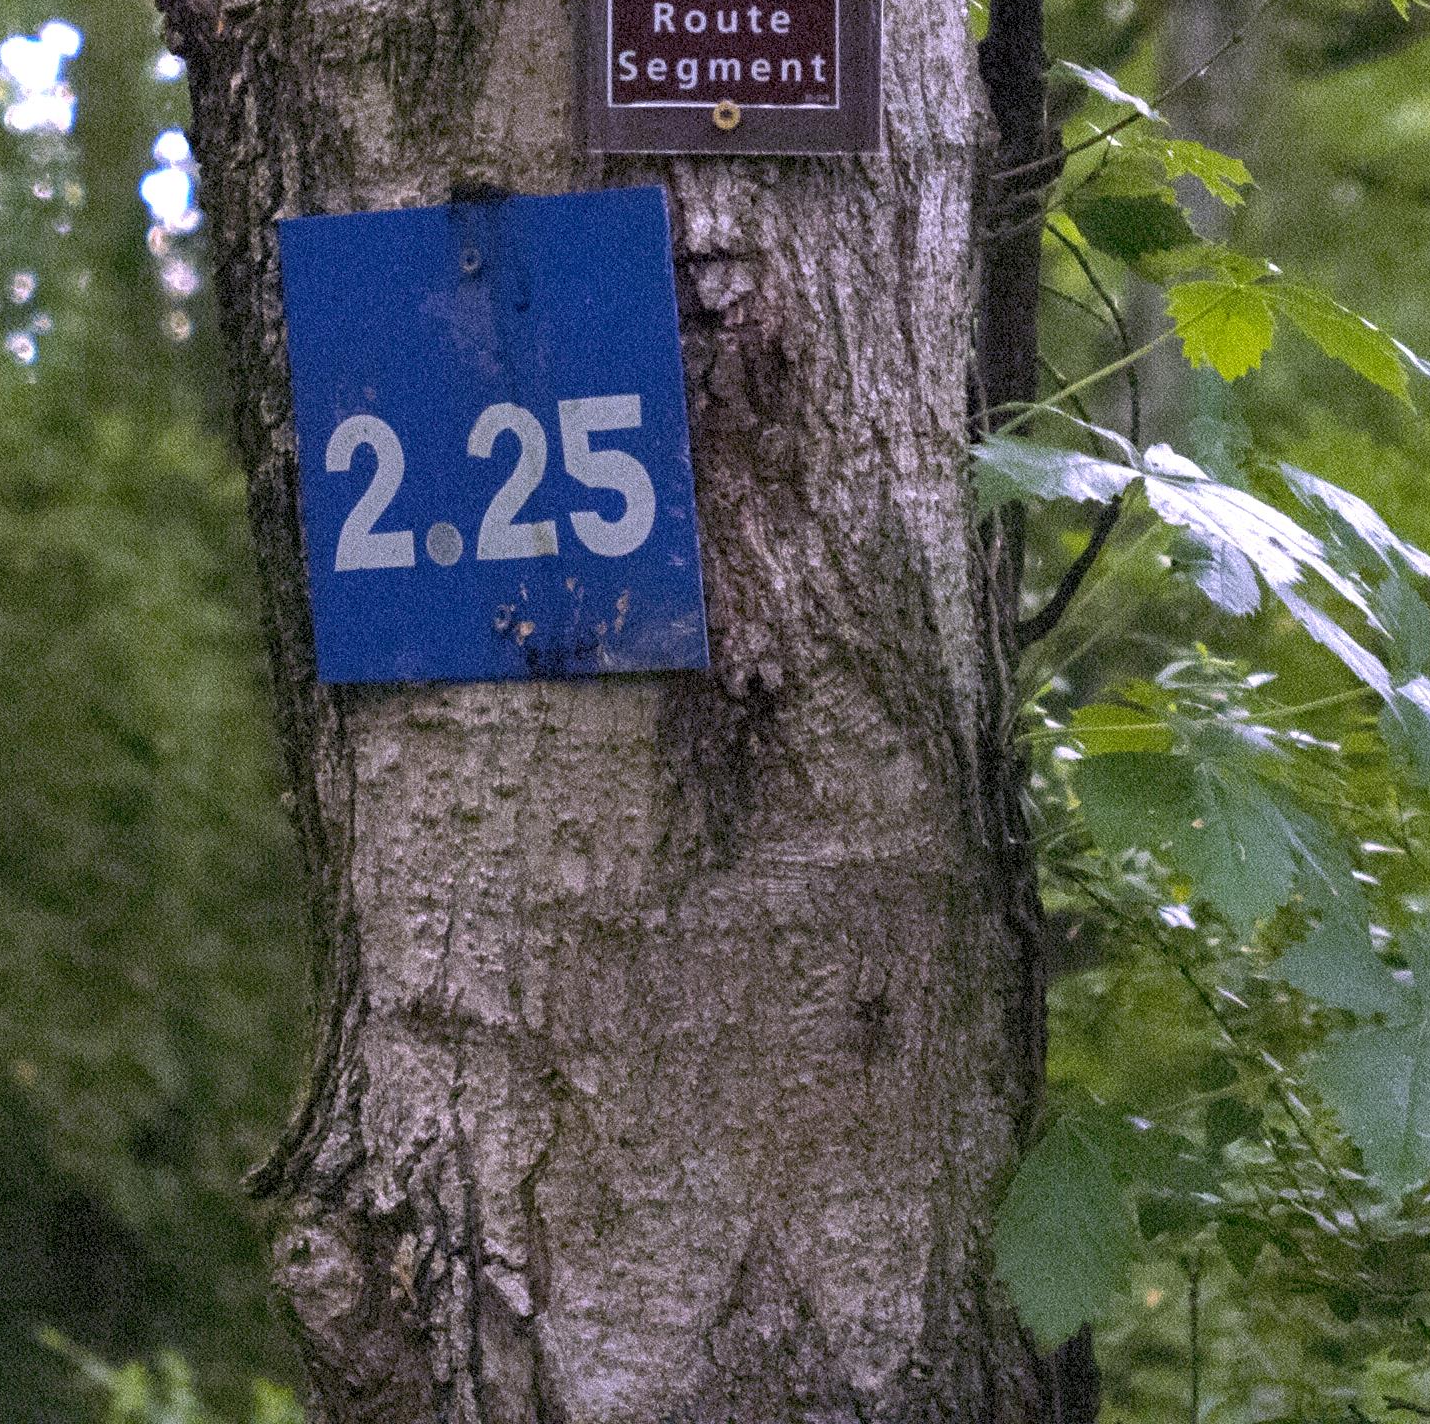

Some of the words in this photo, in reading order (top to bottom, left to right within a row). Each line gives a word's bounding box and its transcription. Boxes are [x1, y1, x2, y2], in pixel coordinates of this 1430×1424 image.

[652, 2, 792, 34] Route
[618, 50, 827, 90] Segment
[325, 393, 657, 572] 2.25
